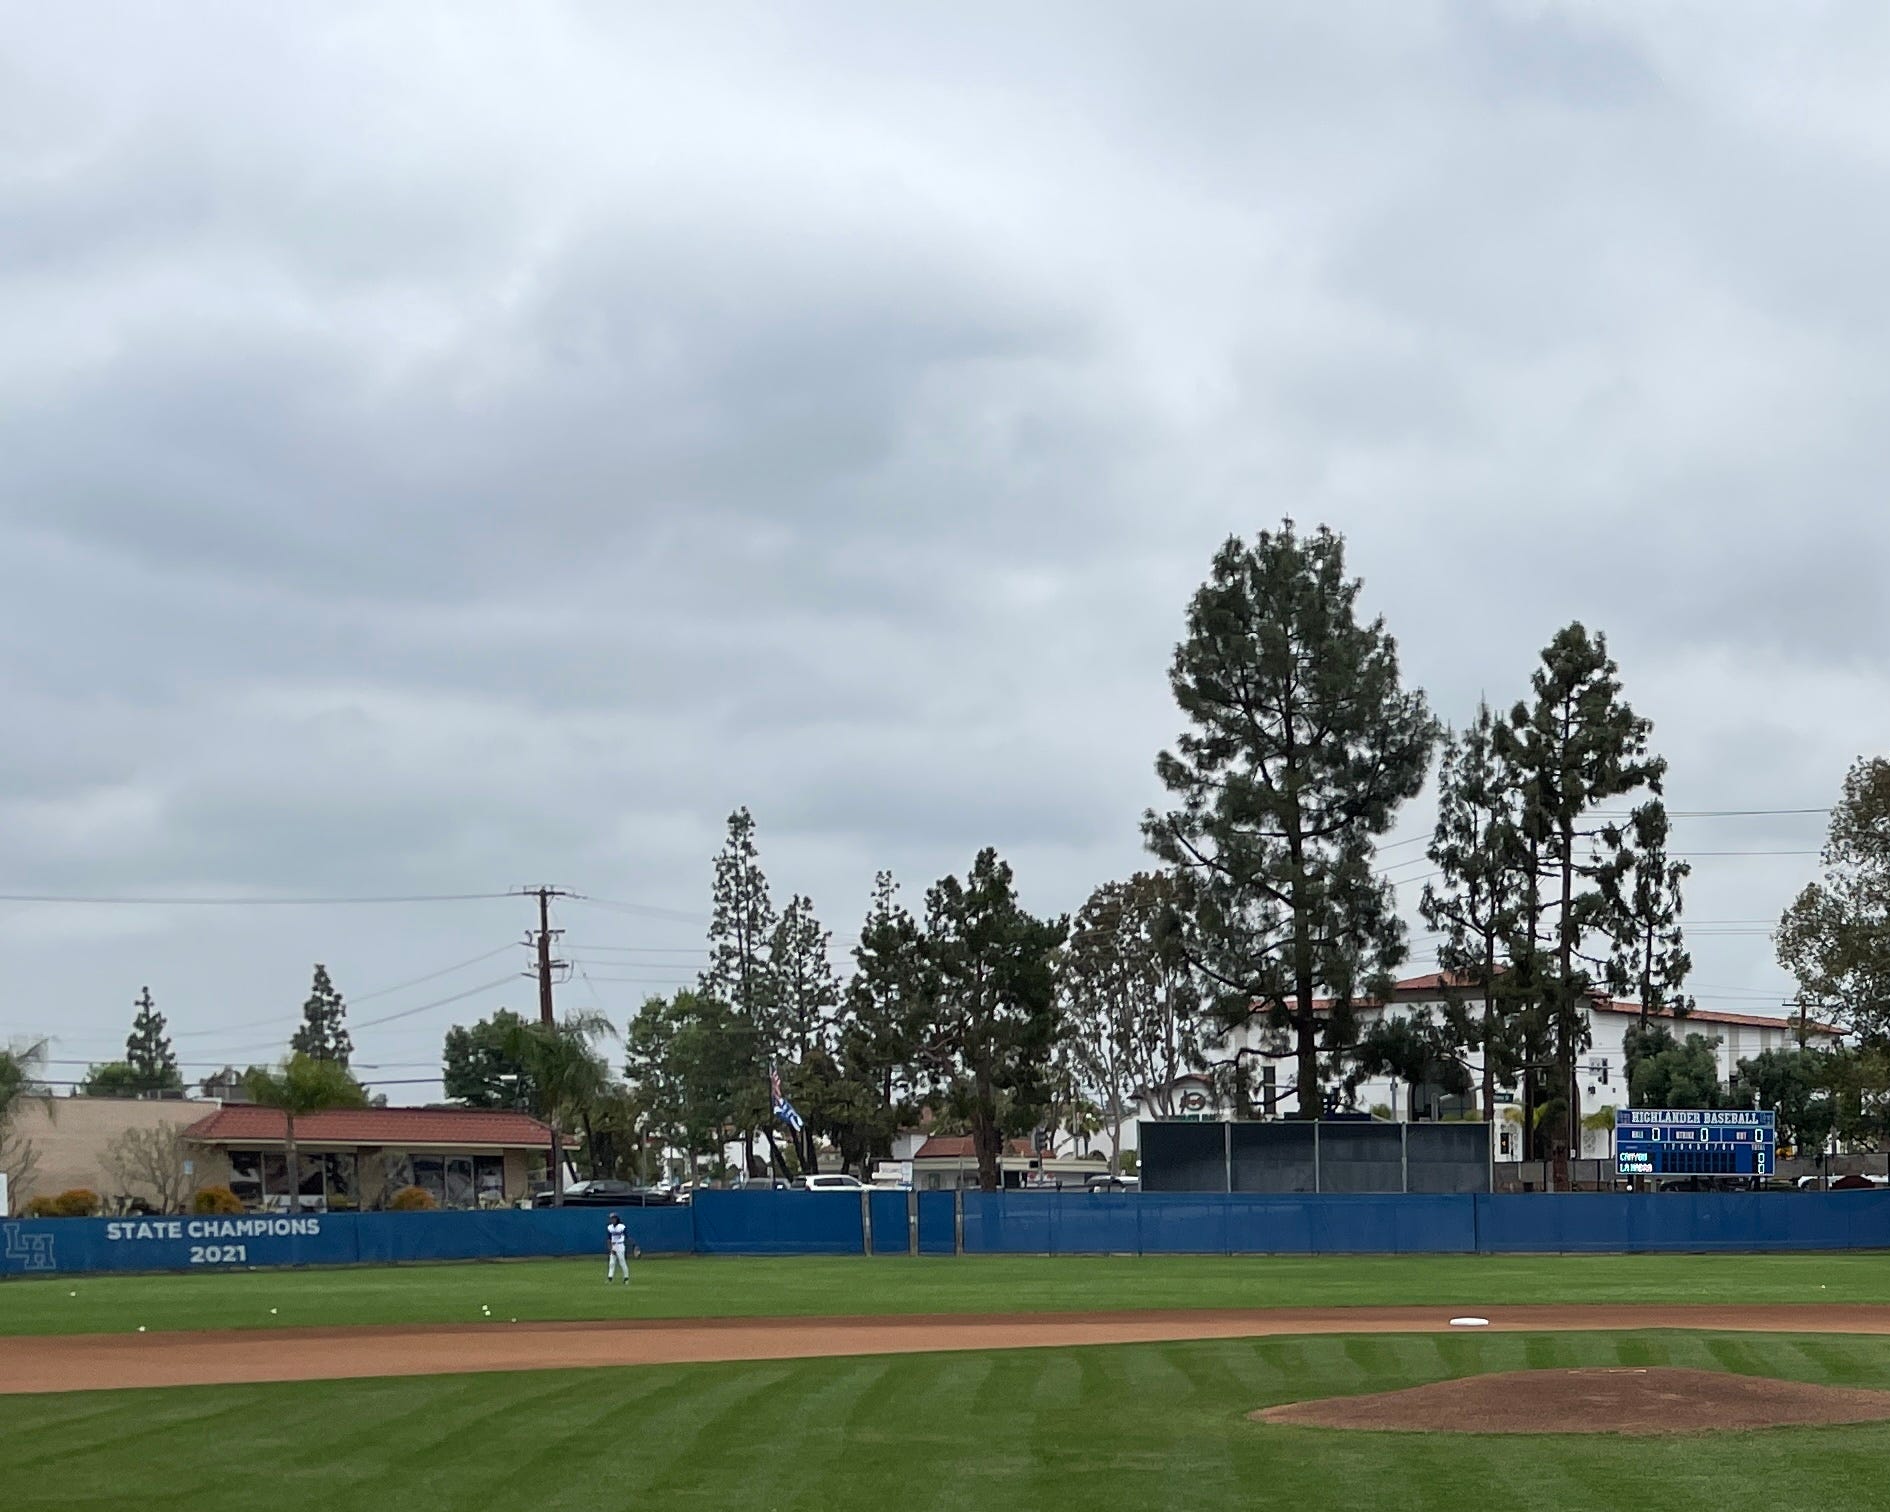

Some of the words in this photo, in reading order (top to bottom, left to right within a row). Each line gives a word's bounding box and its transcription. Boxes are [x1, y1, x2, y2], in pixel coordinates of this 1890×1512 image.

[1631, 1111, 1700, 1124] HIGHLANDER
[1703, 1112, 1759, 1124] BASEBALL
[107, 1221, 183, 1241] STATE
[187, 1218, 321, 1238] CHAMPIONS
[190, 1245, 247, 1264] 2021
